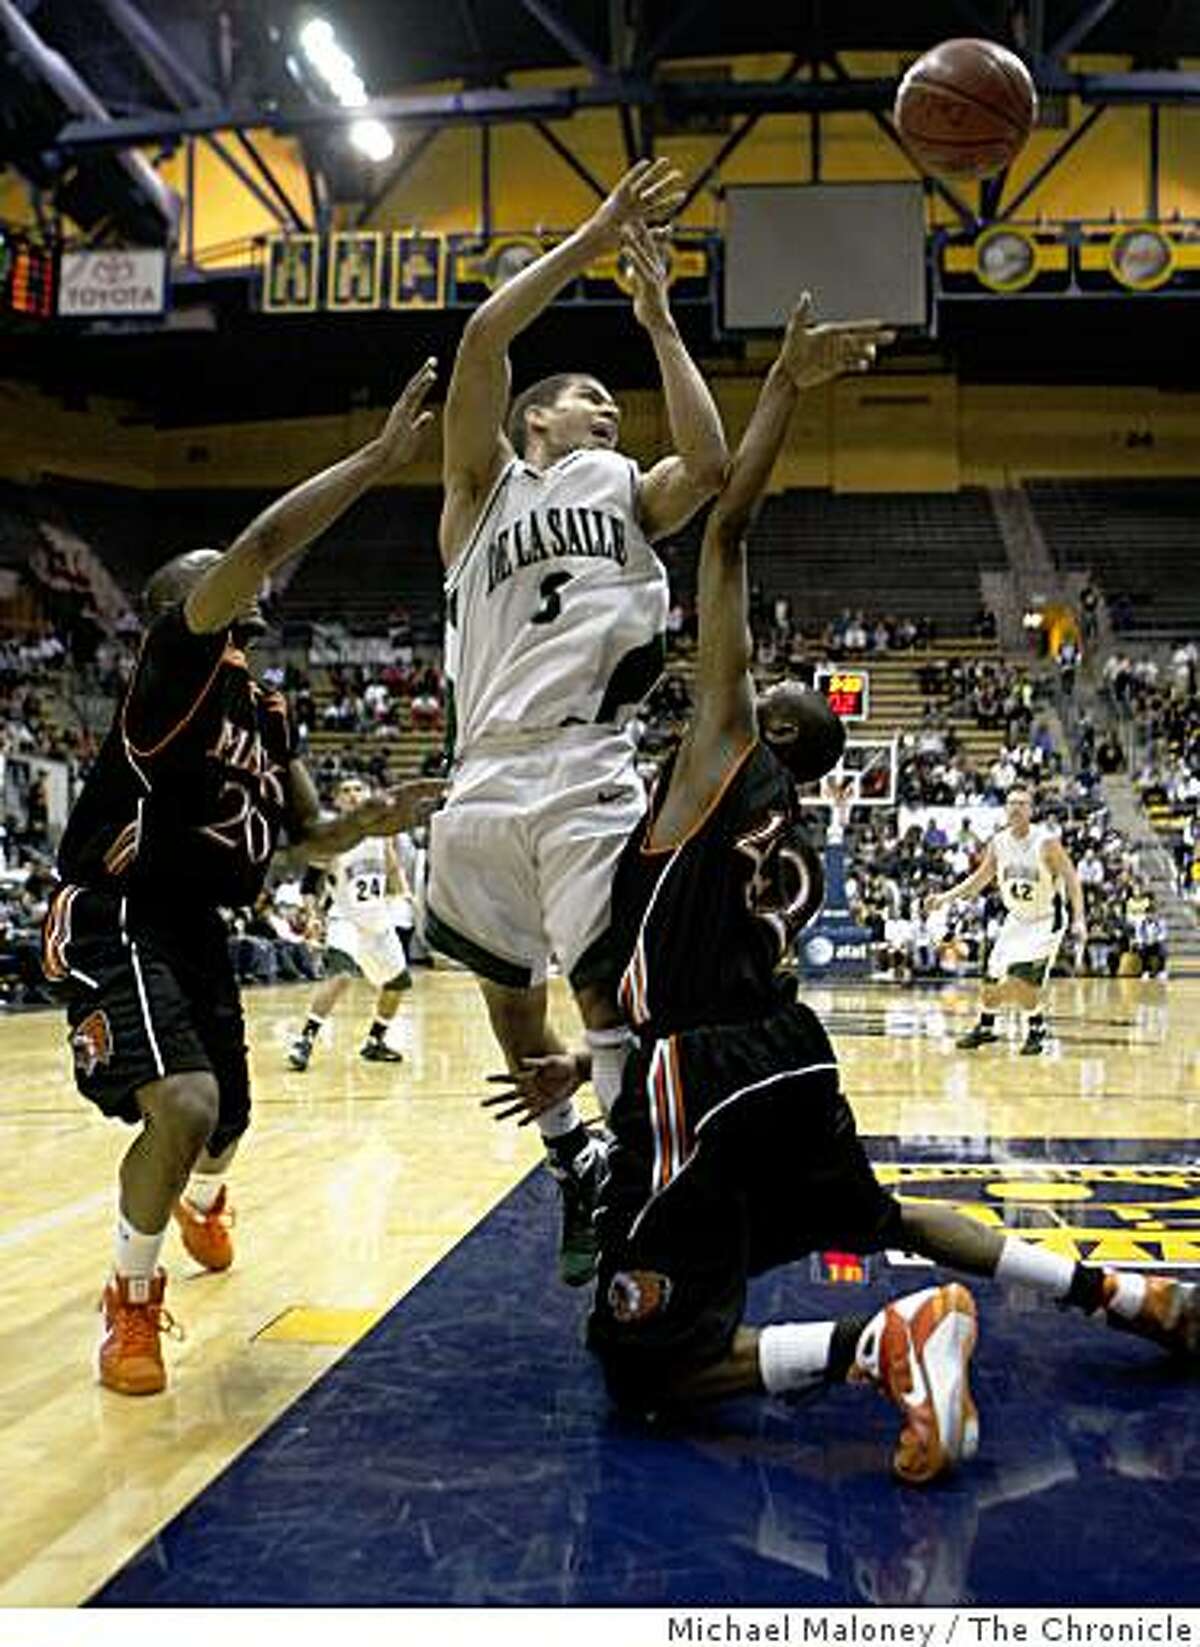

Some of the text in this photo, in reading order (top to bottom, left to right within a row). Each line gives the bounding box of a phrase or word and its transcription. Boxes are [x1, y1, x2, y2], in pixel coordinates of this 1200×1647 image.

[66, 285, 155, 307] TOYOTA
[514, 509, 547, 568] LA
[547, 506, 628, 568] SALLE
[530, 570, 574, 624] 5
[199, 781, 272, 864] 20
[355, 877, 382, 902] 24
[1010, 882, 1034, 902] 42
